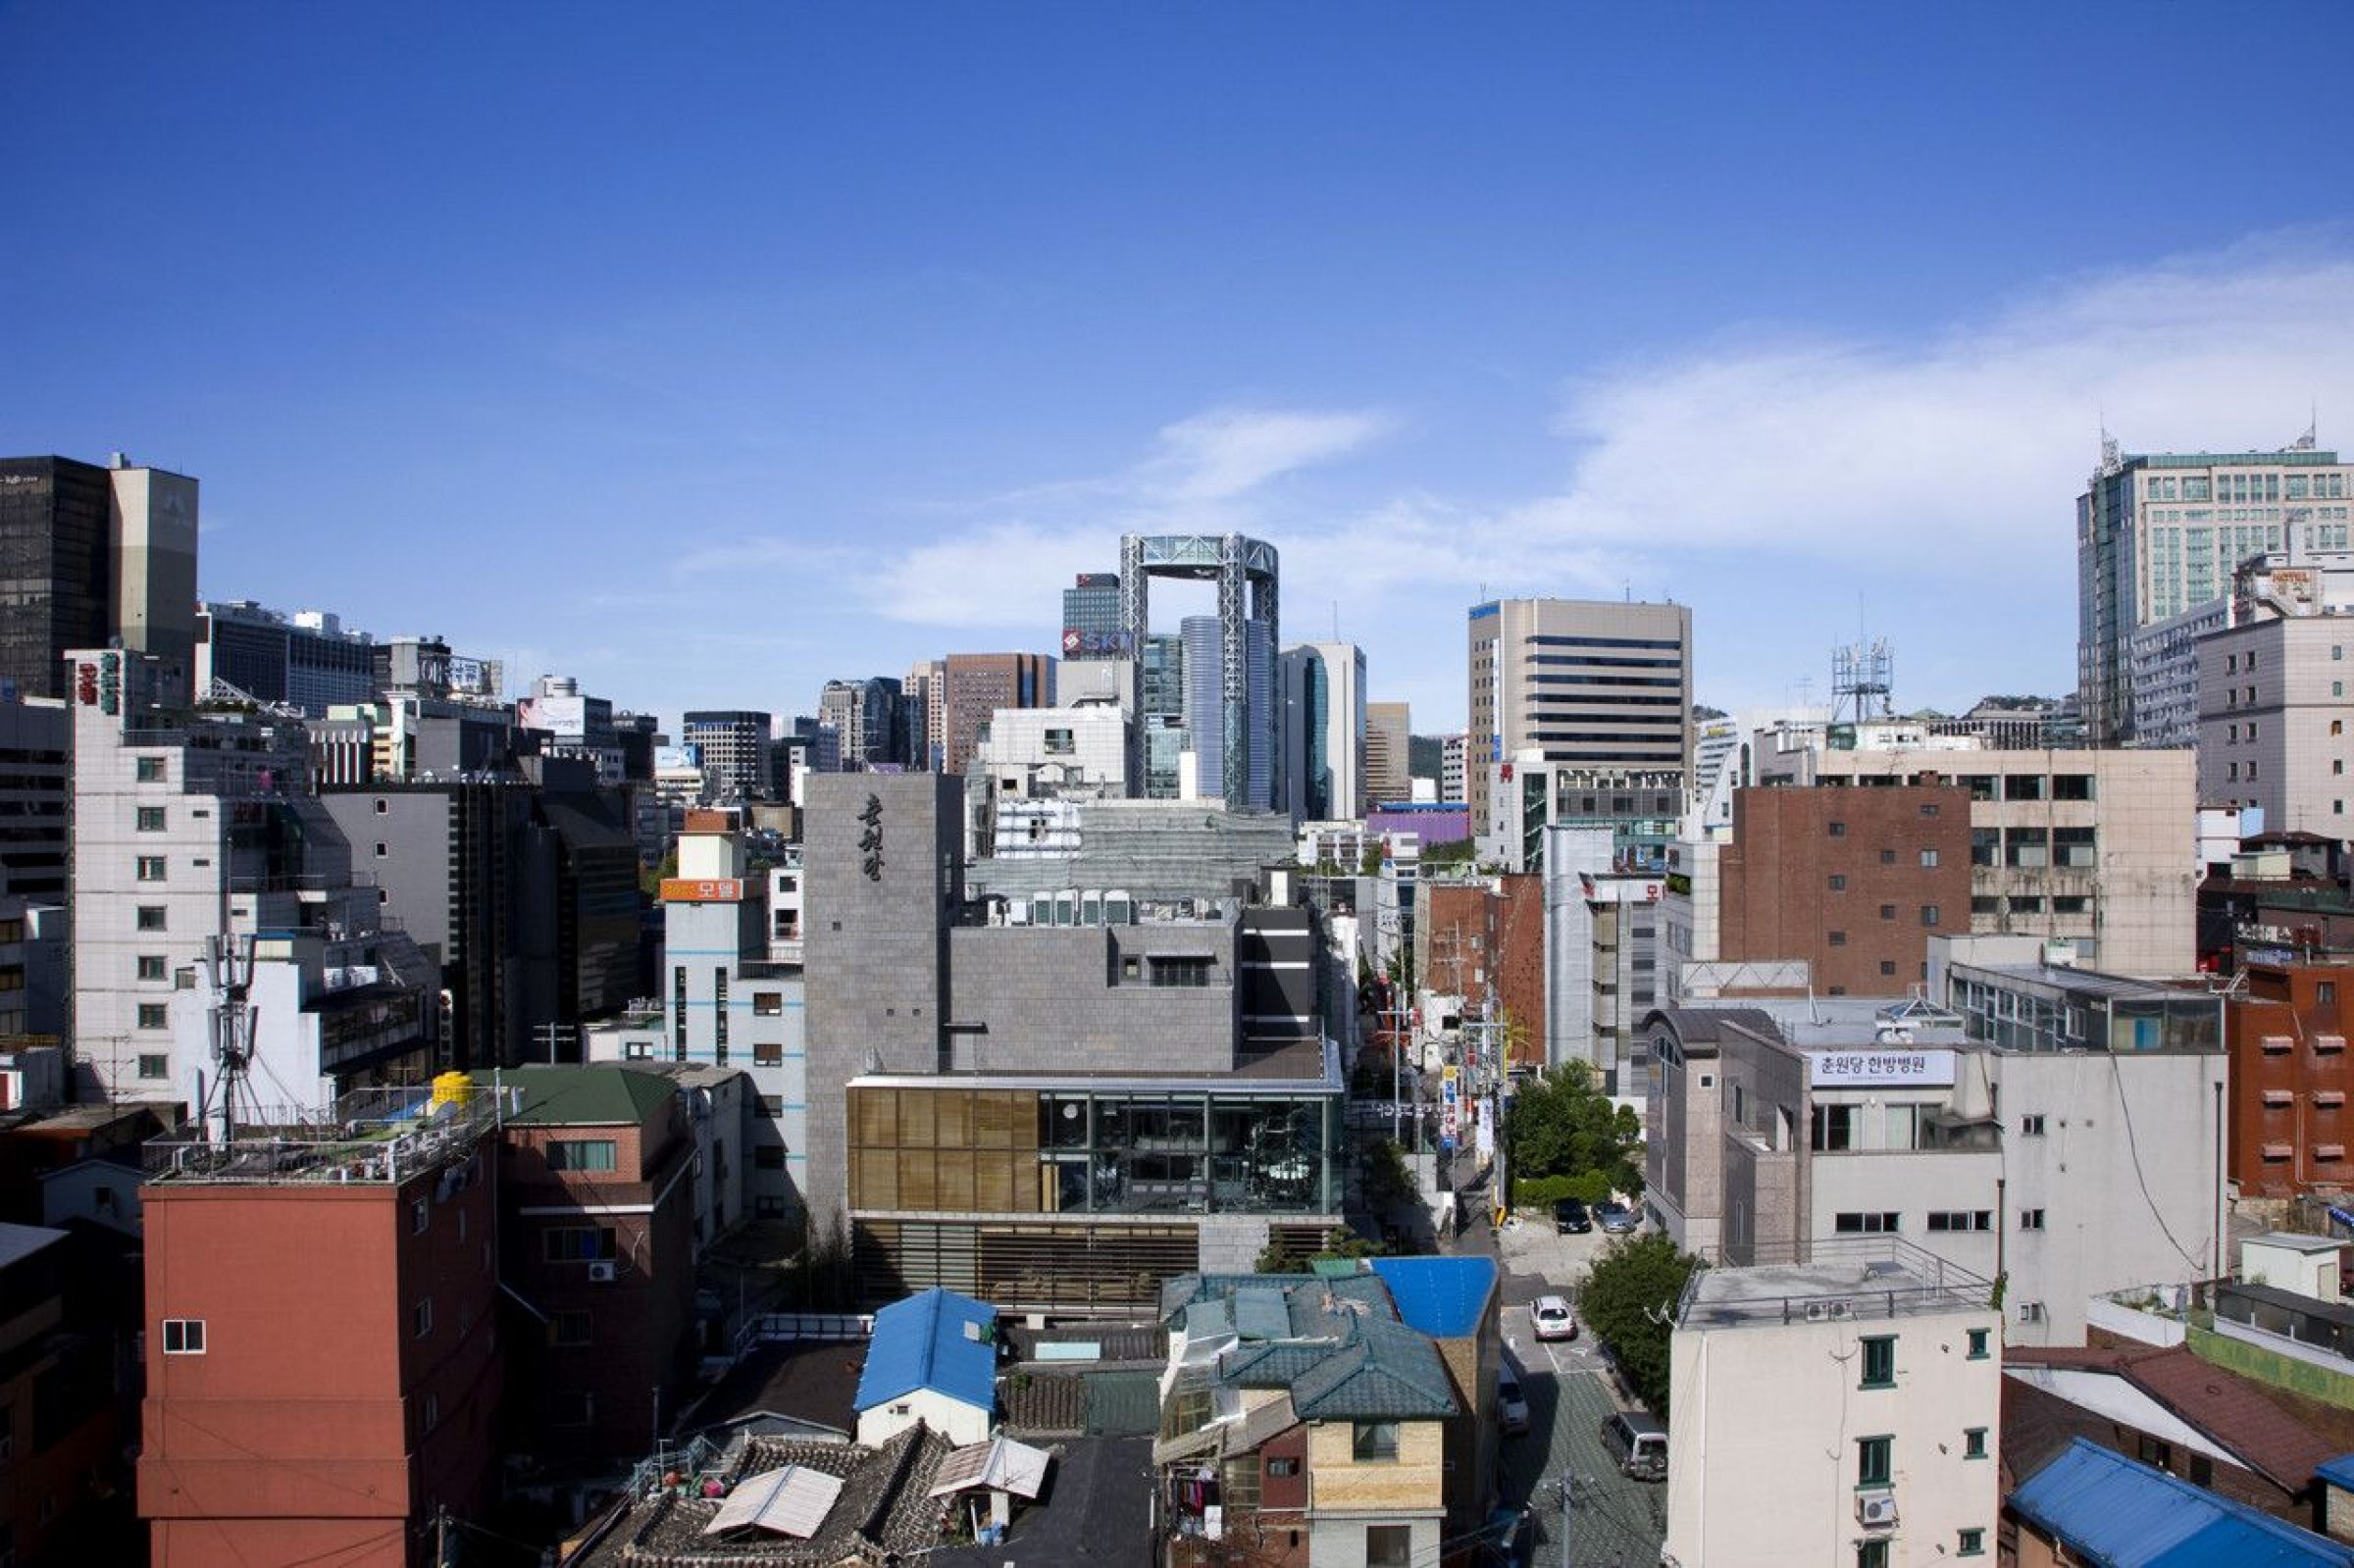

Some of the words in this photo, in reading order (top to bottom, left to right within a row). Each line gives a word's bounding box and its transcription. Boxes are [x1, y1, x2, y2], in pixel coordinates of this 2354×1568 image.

[698, 882, 735, 898] 모텔
[1821, 1056, 1864, 1075] 춘원당
[1868, 1056, 1925, 1075] 한방병원
